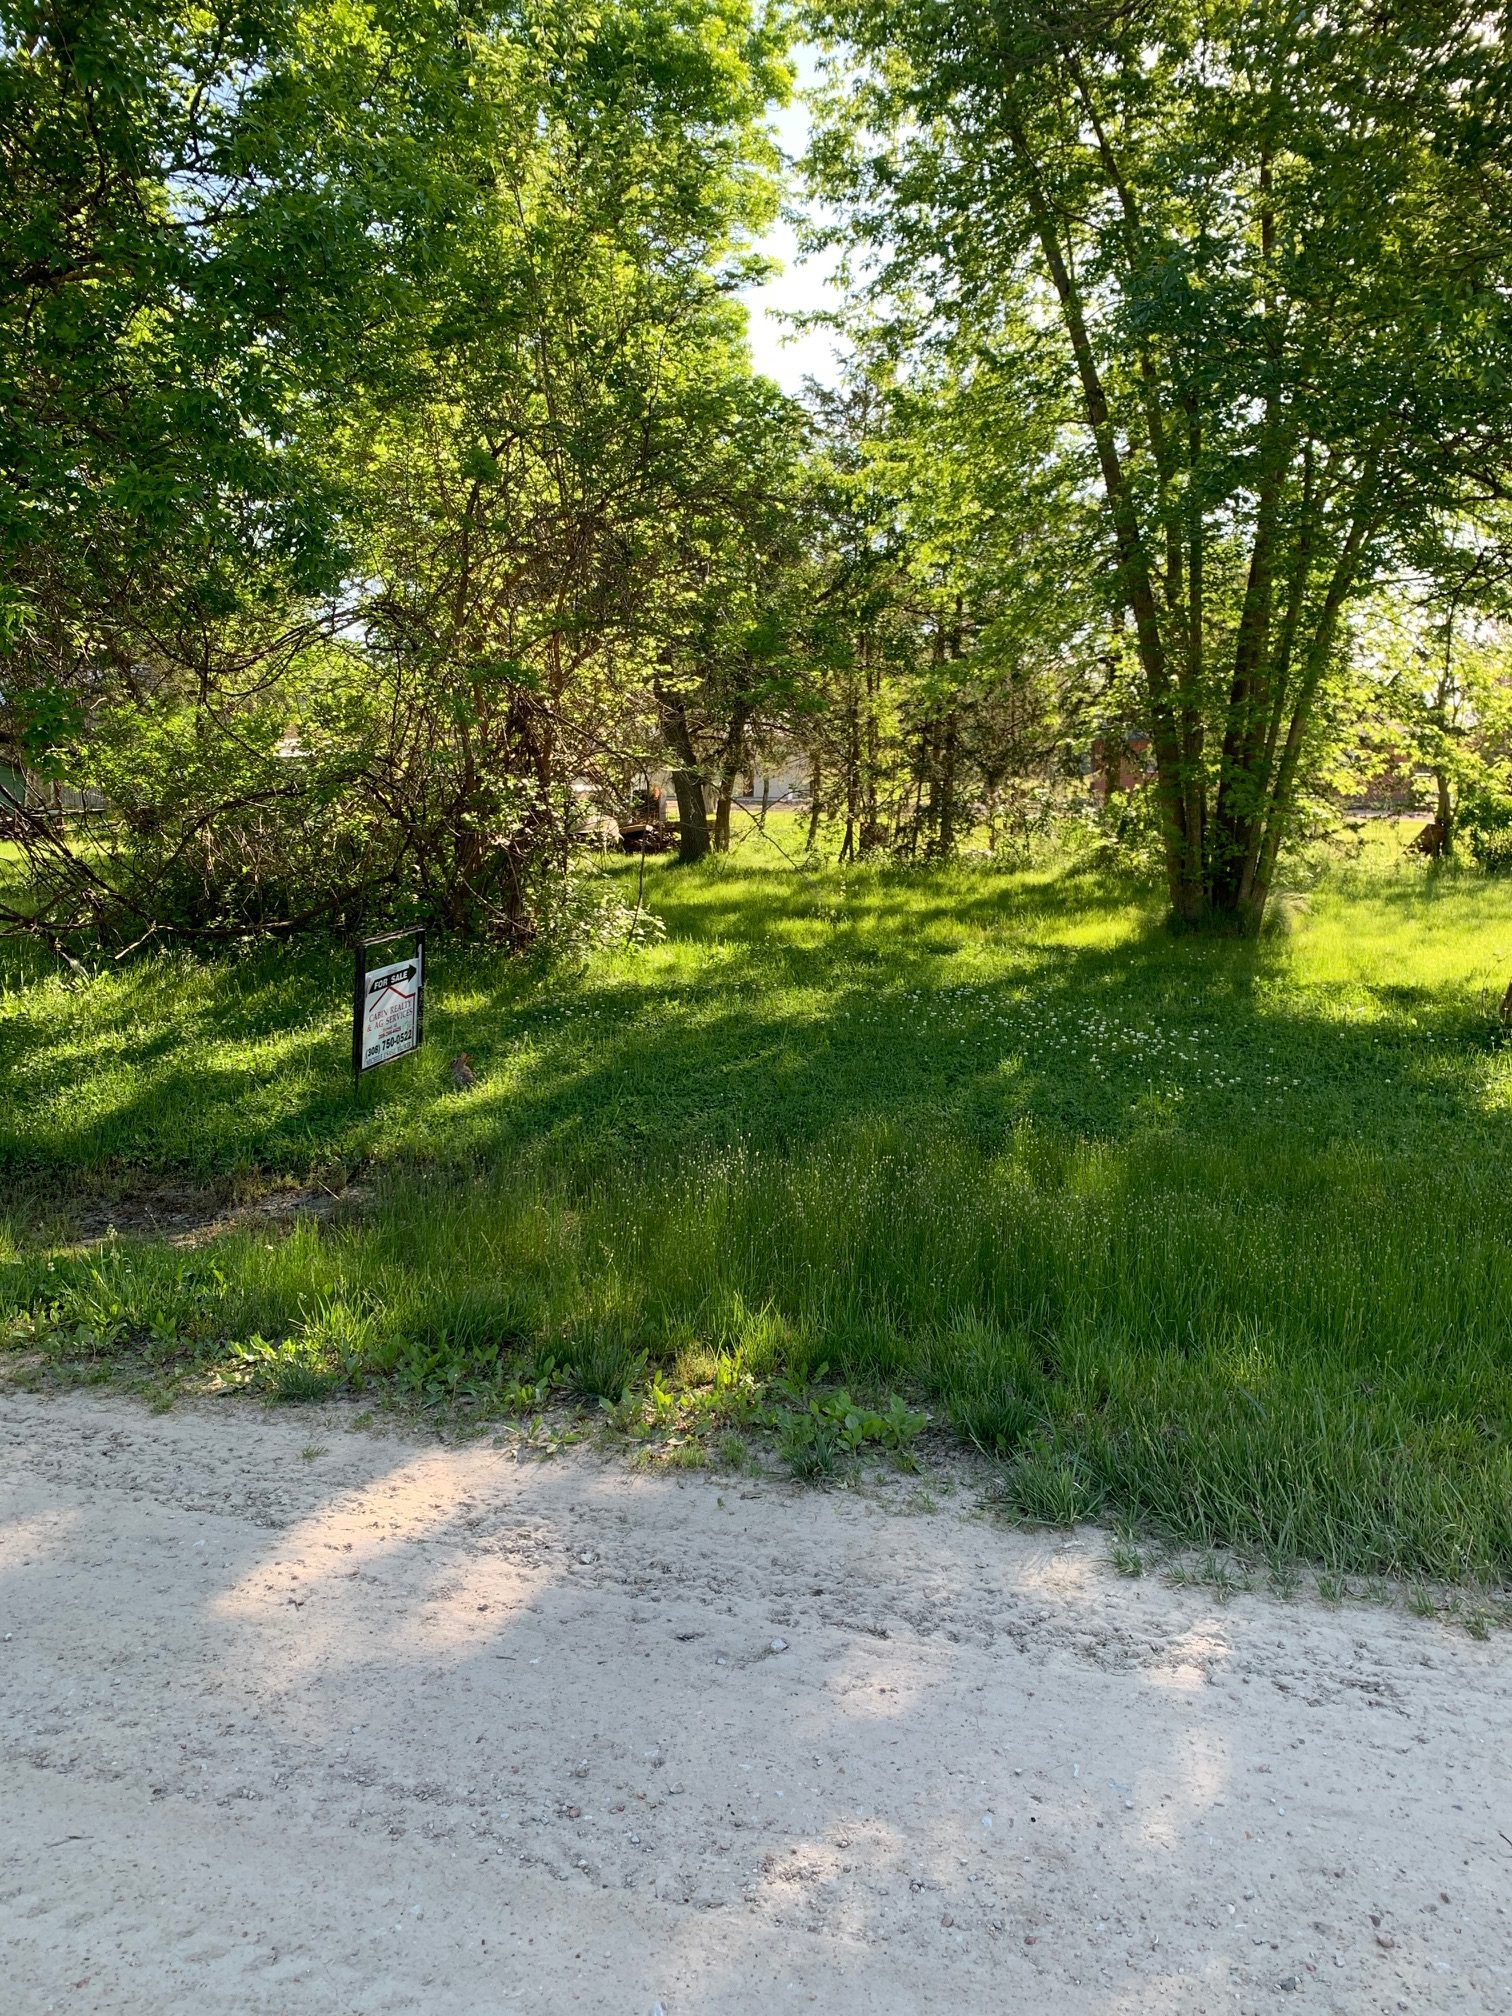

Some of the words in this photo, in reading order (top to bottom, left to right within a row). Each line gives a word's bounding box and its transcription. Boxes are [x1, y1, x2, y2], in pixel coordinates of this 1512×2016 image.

[374, 978, 388, 990] FOR
[390, 970, 408, 983] SALE
[369, 1010, 388, 1022] CABIN
[390, 1000, 411, 1014] REALTY
[374, 1020, 383, 1029] AG
[386, 1008, 413, 1025] SERVICES
[365, 1044, 381, 1059] (308)
[382, 1029, 411, 1051] 750-0522
